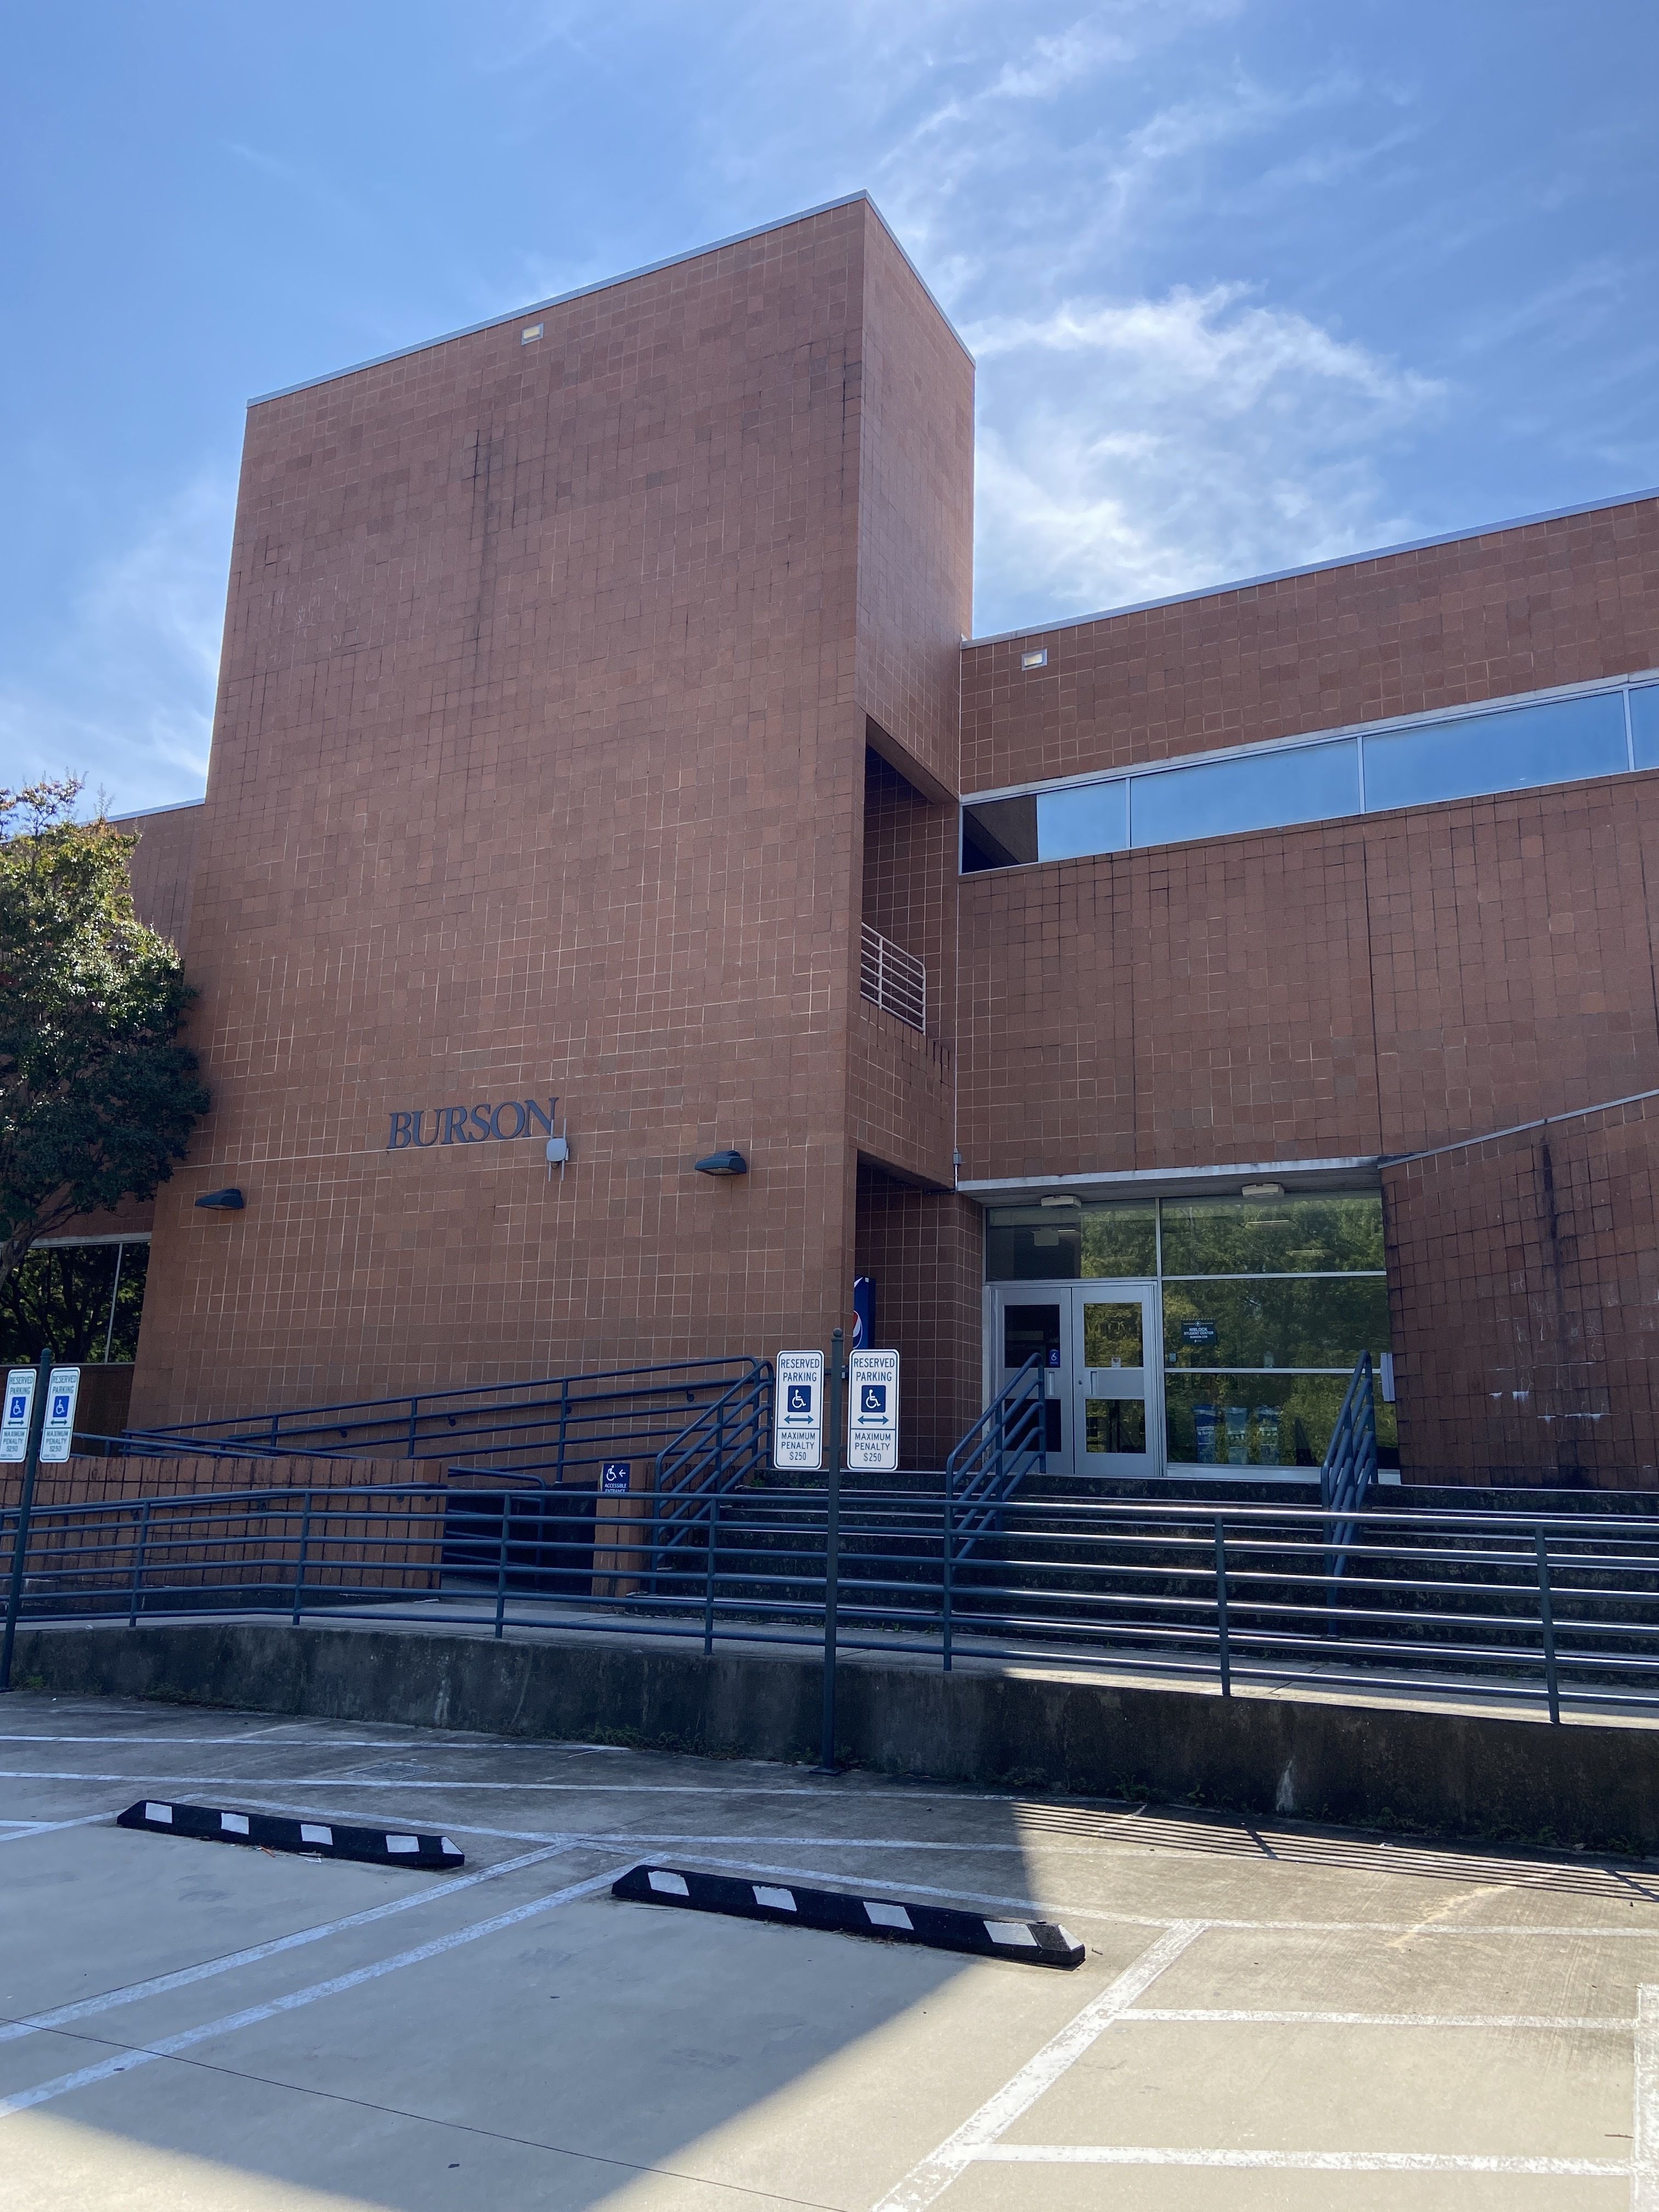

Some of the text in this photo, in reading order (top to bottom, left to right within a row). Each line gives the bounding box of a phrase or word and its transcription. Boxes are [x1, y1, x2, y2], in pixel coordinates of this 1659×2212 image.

[386, 1097, 559, 1149] BURSON
[781, 1358, 820, 1369] RESERVED
[854, 1358, 895, 1368] RESERVED
[9, 1376, 33, 1384] RESERVED
[52, 1375, 77, 1384] RESERVED
[783, 1372, 817, 1382] PARKING
[856, 1372, 892, 1381] PARKING
[9, 1386, 31, 1395] PARKING
[52, 1386, 74, 1394] PARKING
[781, 1432, 815, 1440] MAXIMUM
[855, 1432, 891, 1441] MAXIMUM
[855, 1442, 890, 1451] PENALTY
[789, 1452, 806, 1460] $250
[864, 1453, 882, 1462] $250
